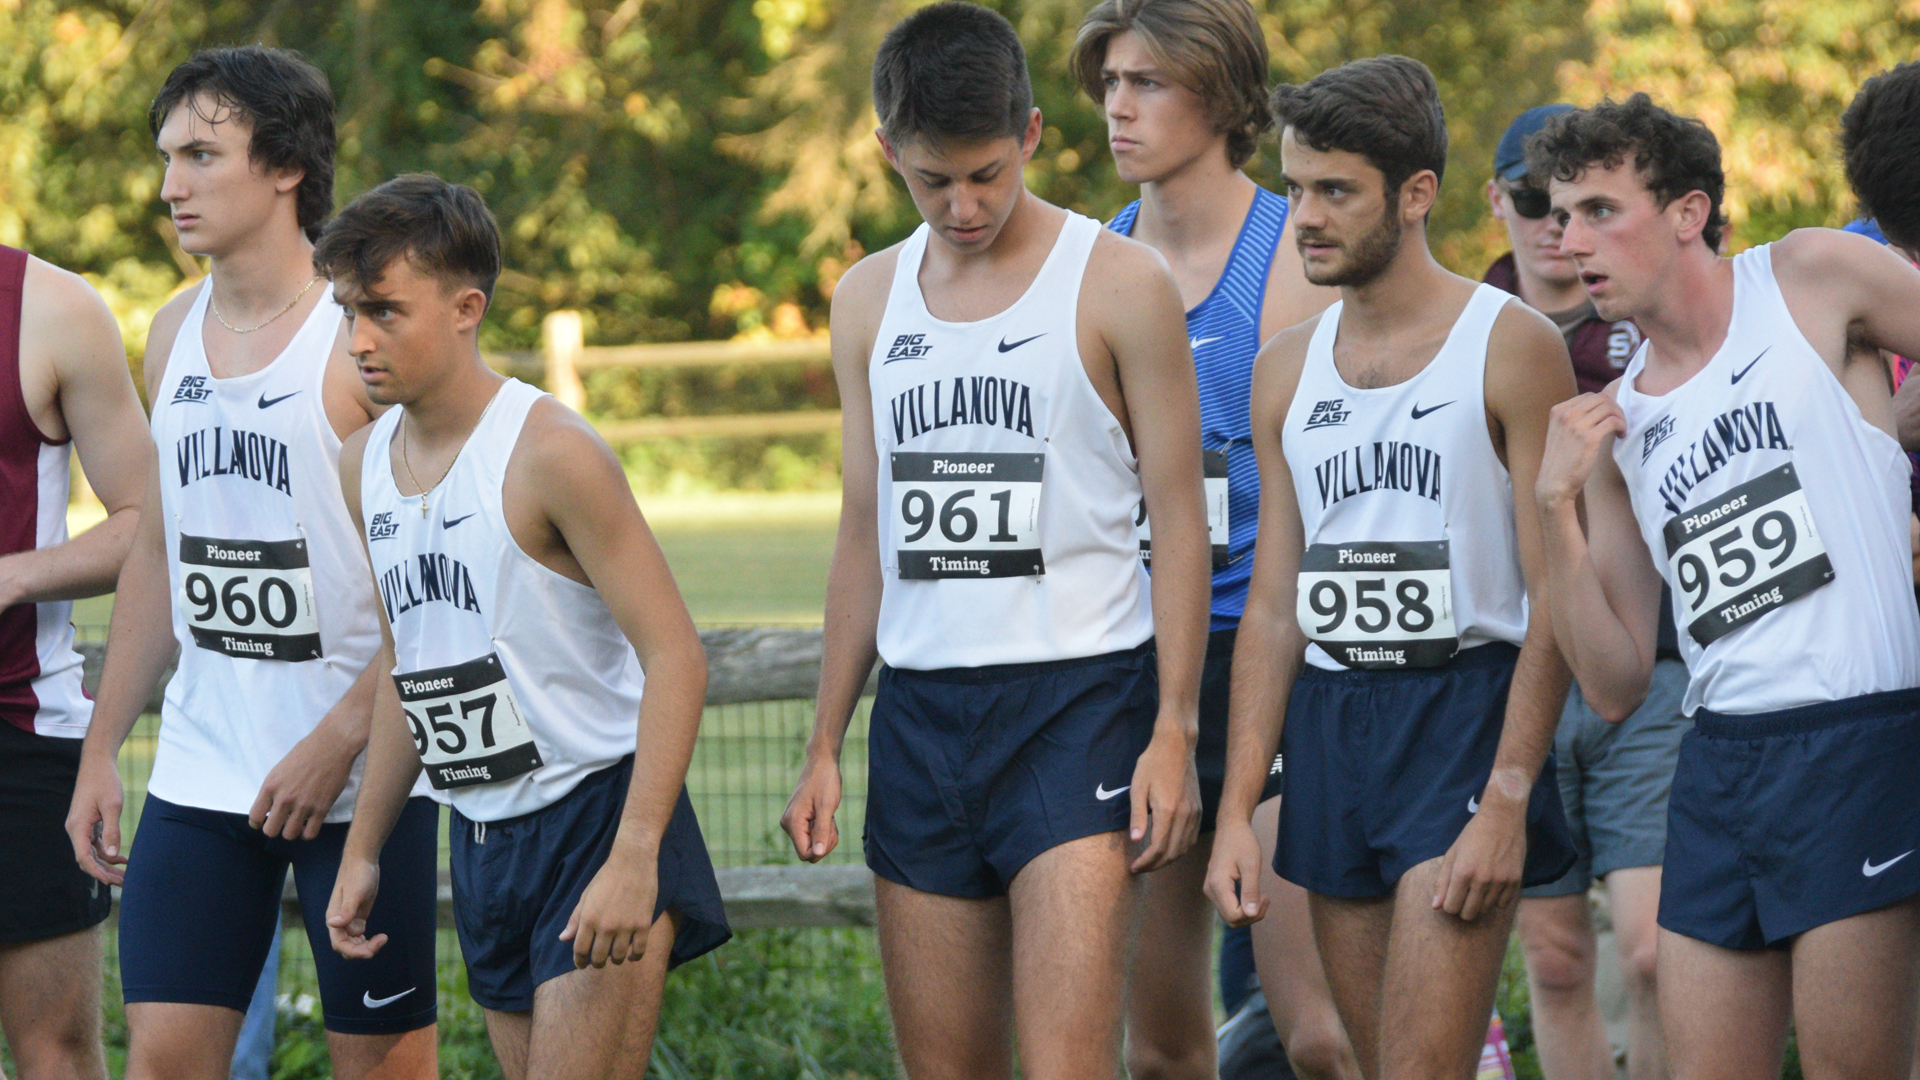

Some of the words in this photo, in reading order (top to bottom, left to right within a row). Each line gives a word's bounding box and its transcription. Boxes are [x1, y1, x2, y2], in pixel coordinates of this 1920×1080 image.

[893, 333, 927, 346] BIG
[886, 345, 934, 359] EAST
[179, 375, 207, 388] BIG
[173, 388, 213, 401] EAST
[891, 376, 1035, 447] VILLANOVA
[1312, 398, 1345, 413] BIG
[1306, 410, 1352, 426] EAST
[1642, 417, 1677, 459] EAST
[1644, 413, 1671, 446] BIG
[932, 459, 995, 474] Pioneer
[1314, 441, 1441, 511] VILLANOVA
[372, 511, 393, 525] BIG
[901, 488, 1019, 544] 961
[1682, 494, 1748, 534] Pioneer
[369, 523, 400, 537] EAST
[206, 544, 262, 562] Pioneer
[1338, 548, 1397, 564] Pioneer
[1677, 509, 1797, 613] 959
[929, 556, 991, 575] Timing
[185, 572, 298, 629] 960
[1308, 577, 1435, 634] 958
[1720, 585, 1784, 624] Timing
[222, 636, 274, 656] Timing
[1346, 646, 1407, 665] Timing
[401, 677, 455, 695] Pioneer
[403, 692, 498, 757] 957
[439, 764, 492, 783] Timing
